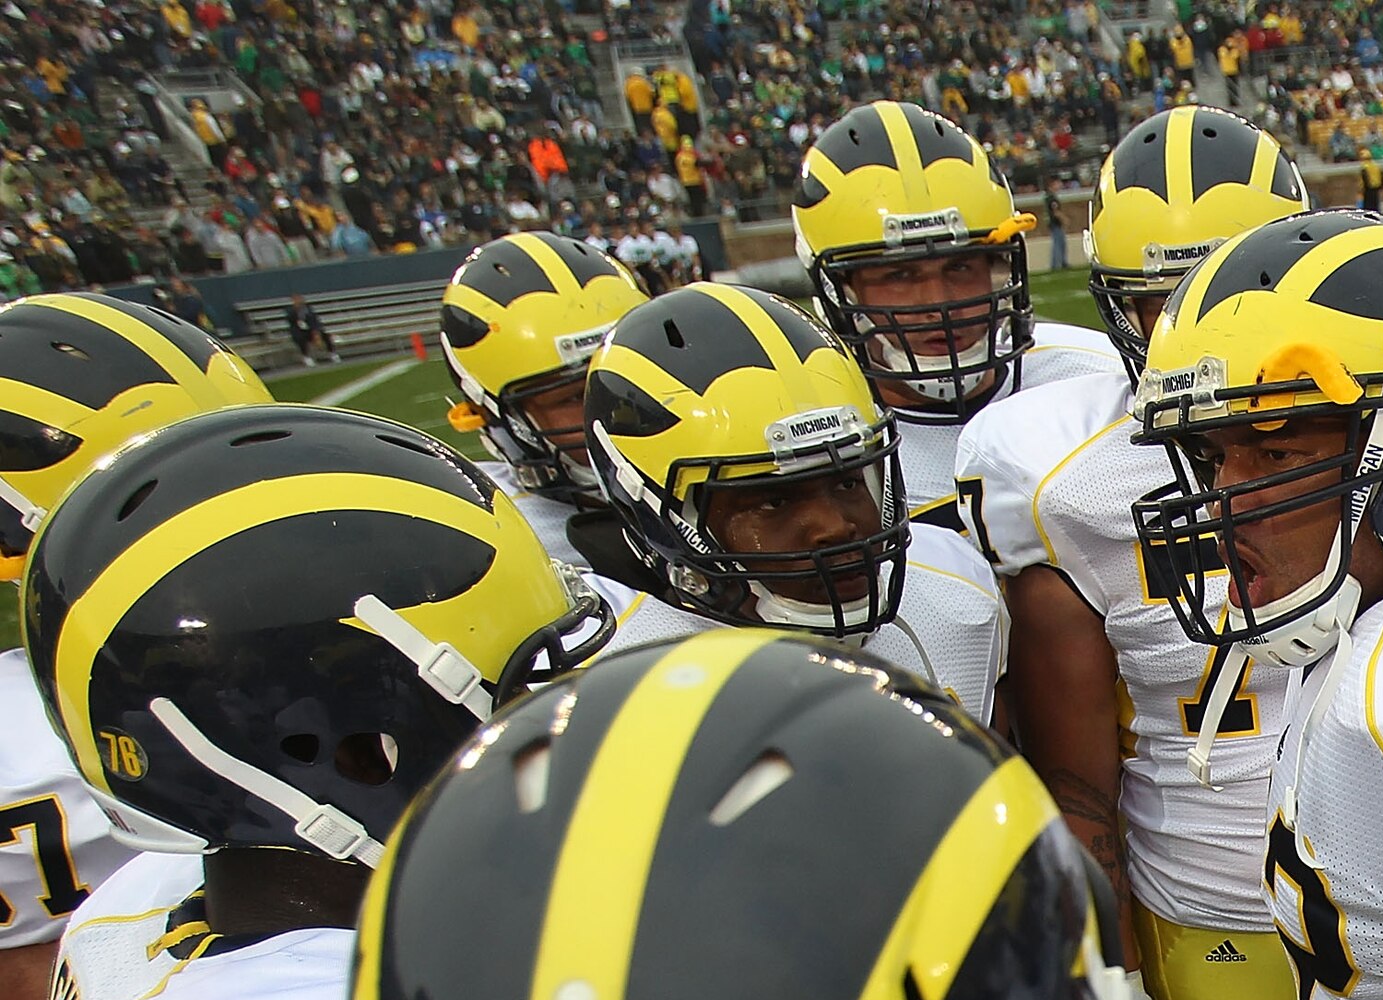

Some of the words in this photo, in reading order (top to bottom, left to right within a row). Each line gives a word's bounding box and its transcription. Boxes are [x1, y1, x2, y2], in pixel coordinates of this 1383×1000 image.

[1163, 244, 1210, 261] MICHIGAN
[789, 413, 841, 438] MICHIGAN
[99, 731, 141, 777] 76
[1205, 953, 1247, 962] adidas
